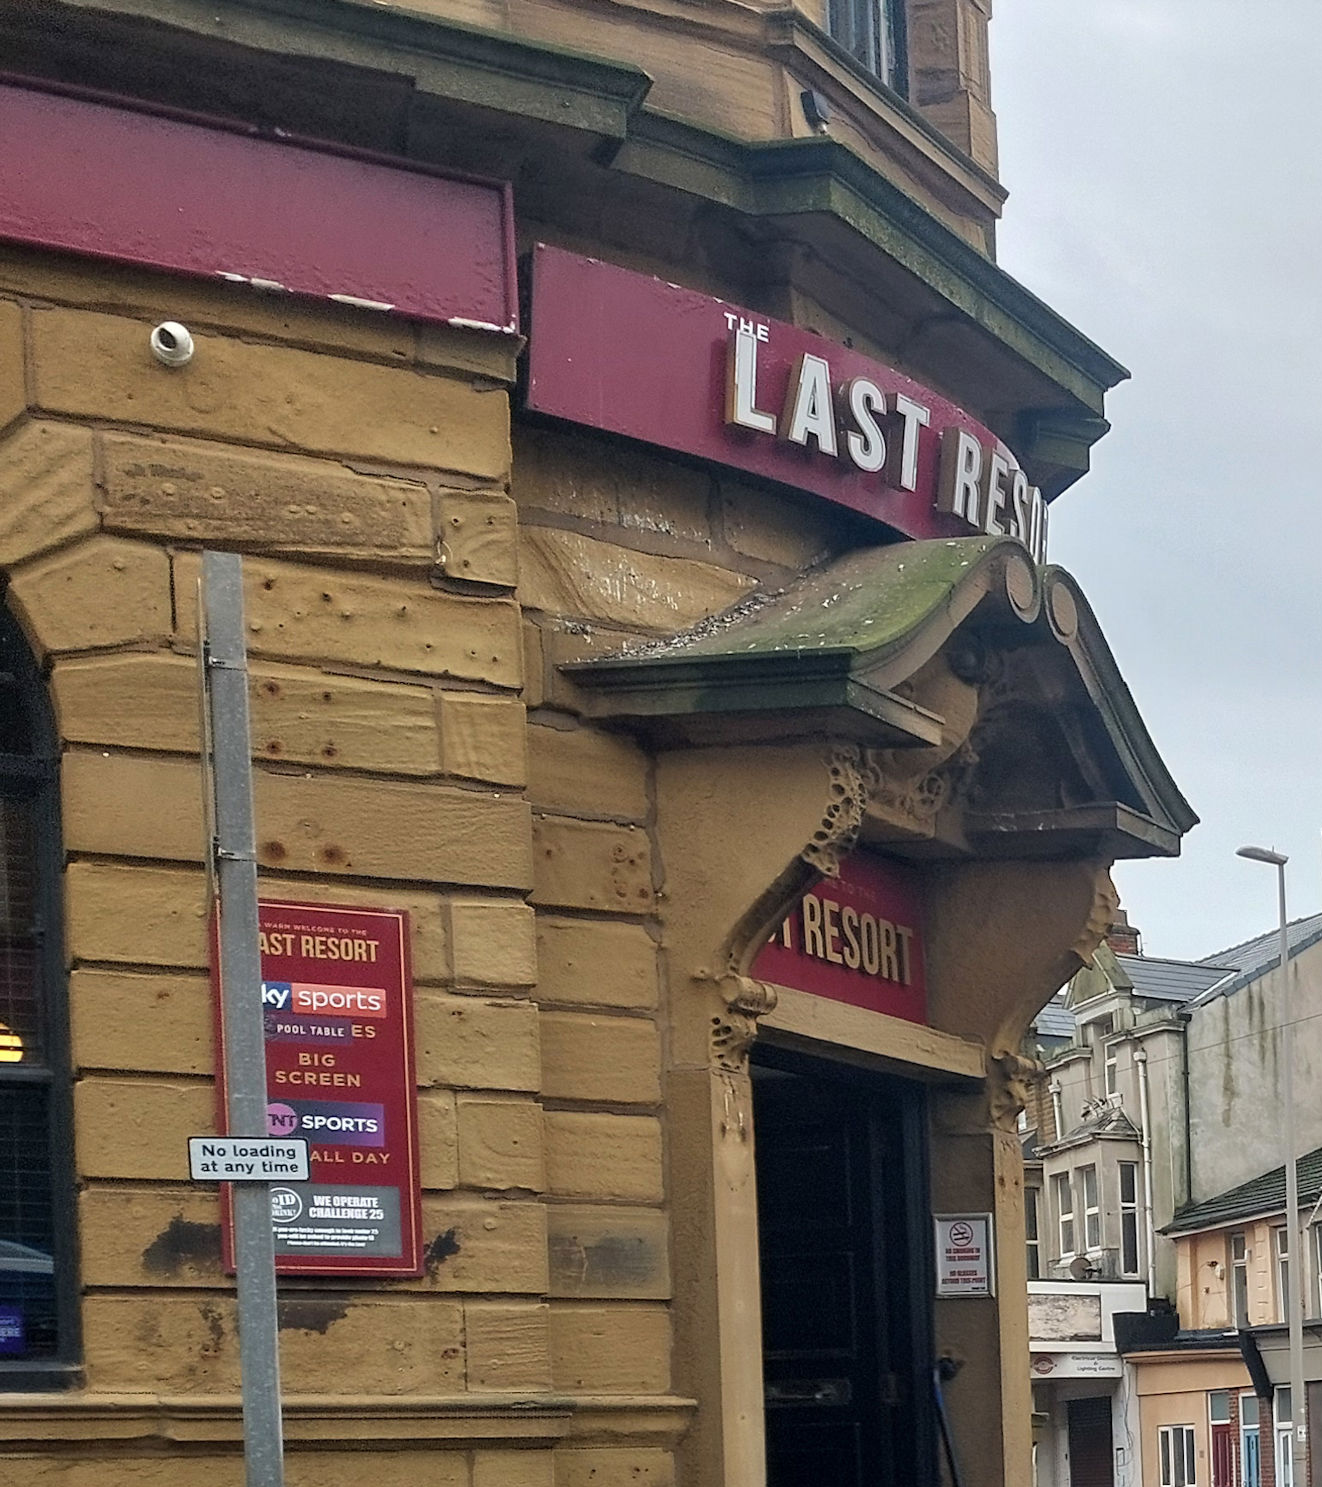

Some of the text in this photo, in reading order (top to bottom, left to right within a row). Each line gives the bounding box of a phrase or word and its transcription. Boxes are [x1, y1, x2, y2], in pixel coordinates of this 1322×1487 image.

[724, 312, 770, 343] THE
[728, 329, 930, 492] LAST
[258, 932, 380, 963] AST RESORT
[803, 894, 913, 985] RESORT
[261, 983, 381, 1011] ky sports
[277, 1024, 306, 1034] POOL
[310, 1026, 345, 1037] TABLE
[299, 1053, 336, 1067] BIG
[275, 1070, 361, 1088] SCREEN
[301, 1115, 378, 1133] SPORTS
[202, 1144, 296, 1160] No loading
[310, 1150, 391, 1164] ALL DAY
[200, 1160, 299, 1175] at any time
[313, 1195, 378, 1208] WE OPERATE
[309, 1207, 384, 1220] CHALLENGE 25
